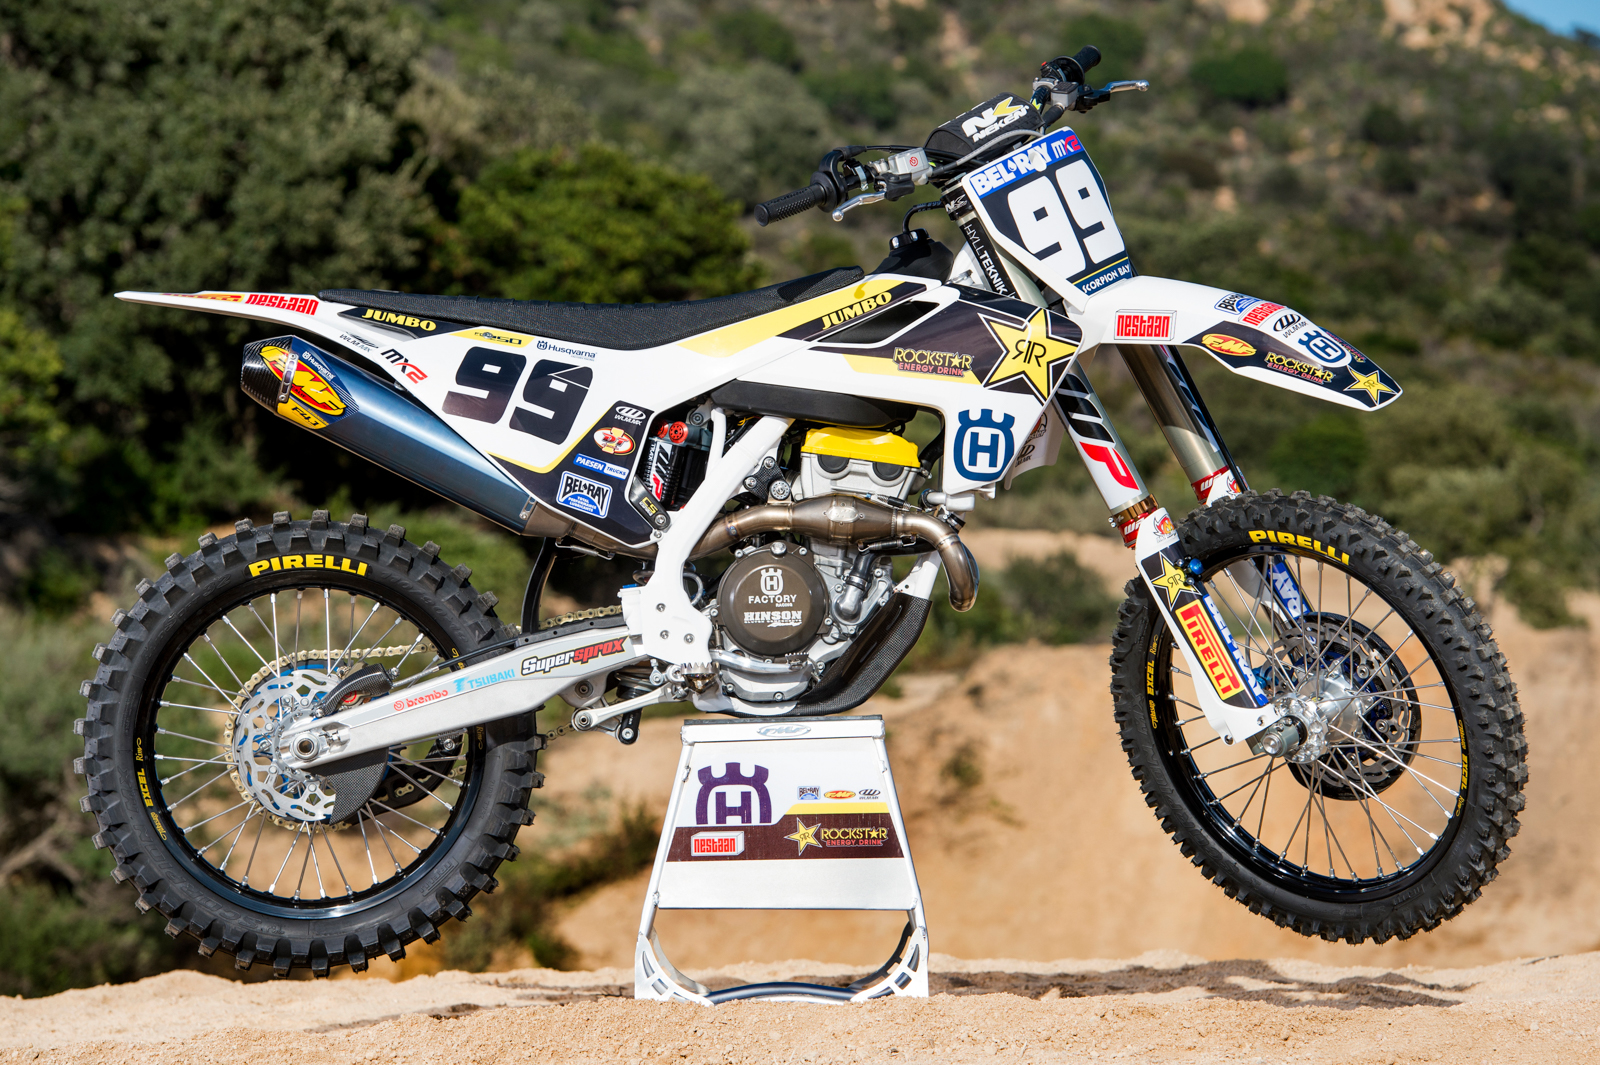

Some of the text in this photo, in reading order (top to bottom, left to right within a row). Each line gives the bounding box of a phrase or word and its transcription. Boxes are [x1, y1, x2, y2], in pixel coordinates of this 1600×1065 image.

[972, 105, 1029, 143] NEKEN
[1007, 159, 1125, 277] 99
[964, 223, 1007, 296] HYLLTEKNIK
[1082, 264, 1130, 293] SCORPION BAY
[245, 294, 319, 316] nestaan
[822, 291, 892, 331] JUMBO
[361, 308, 437, 332] JUMBO
[1117, 314, 1171, 338] nestaan
[548, 344, 597, 359] Husqvarna
[309, 356, 336, 380] Husqvarna
[380, 348, 428, 385] MX2
[898, 362, 964, 377] ENERGY DRINK
[1268, 362, 1324, 384] ENERGY DRINK
[442, 346, 593, 445] 99
[602, 432, 629, 446] DT
[576, 457, 626, 476] PAESEN TRUCKS
[1249, 530, 1350, 565] PIRELLI
[248, 554, 368, 577] PIRELLI
[748, 594, 797, 604] FACTORY
[744, 610, 802, 621] HINSON
[521, 636, 629, 675] Supersprox
[1180, 604, 1240, 694] PIRELLI
[467, 669, 515, 690] TSUBAKI
[407, 689, 448, 707] brembo
[1462, 754, 1470, 790] EXCEL
[137, 768, 153, 807] EXCEL
[694, 837, 736, 853] nestaan
